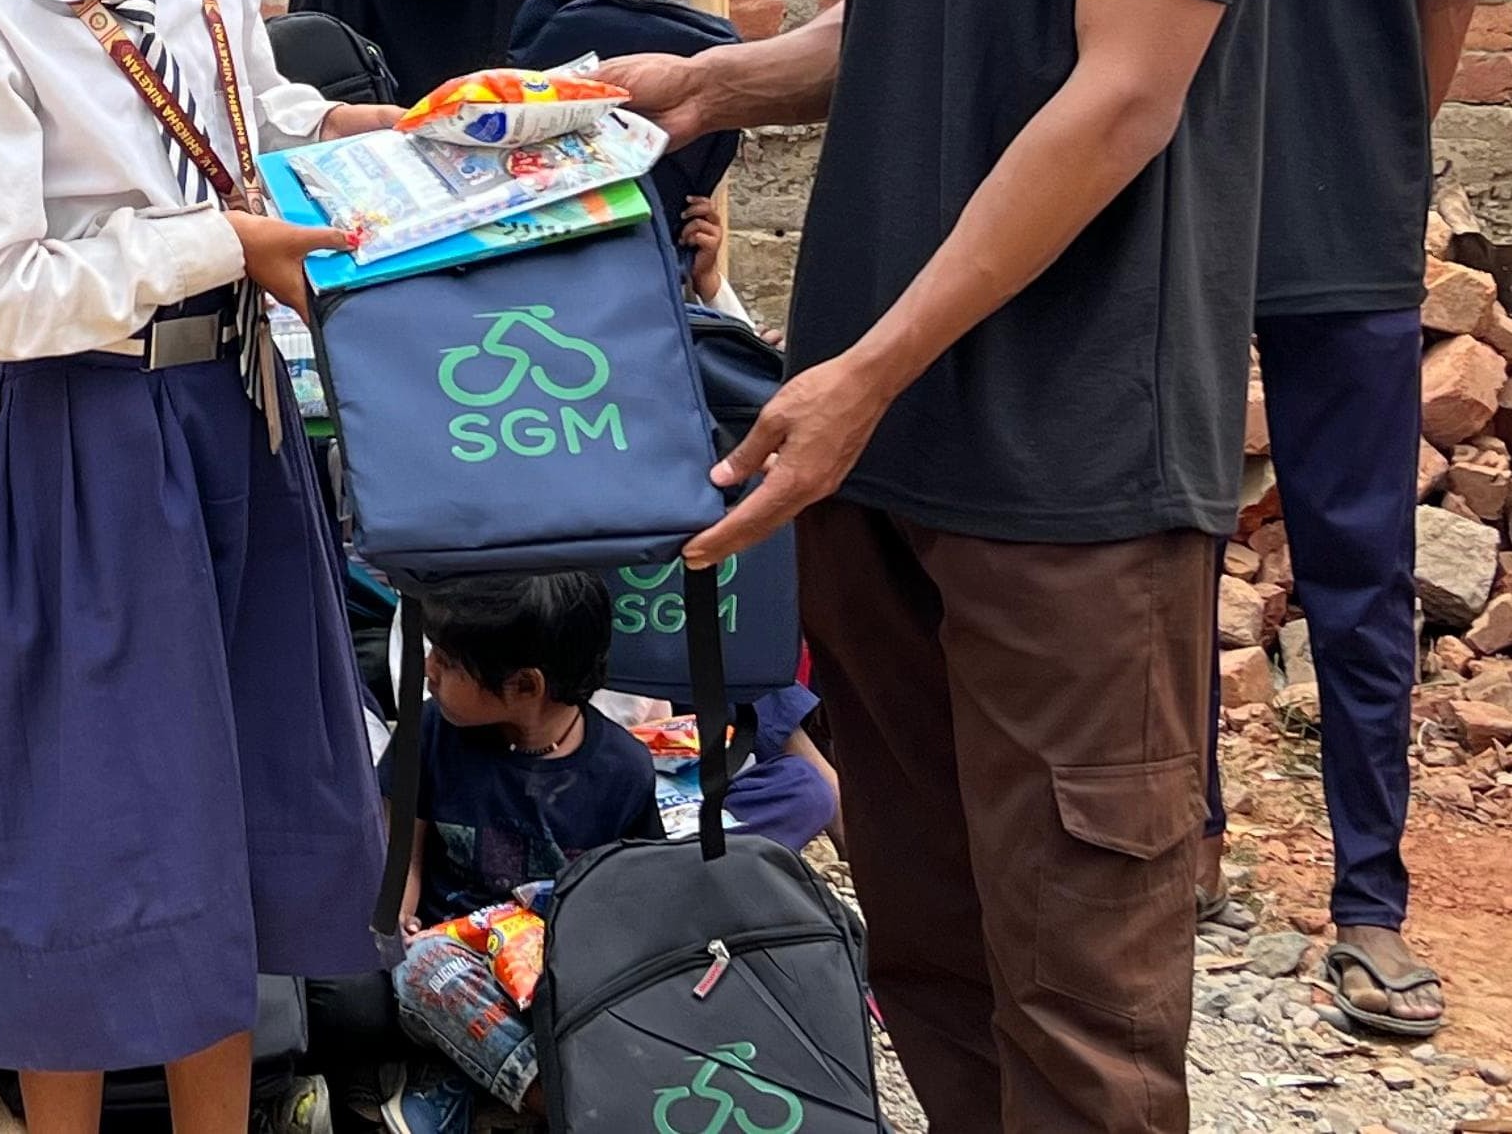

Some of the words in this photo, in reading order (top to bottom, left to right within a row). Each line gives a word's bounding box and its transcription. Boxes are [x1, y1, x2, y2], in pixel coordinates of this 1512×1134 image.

[122, 53, 166, 108] NIKETAN
[213, 22, 233, 82] NIKETAN
[162, 104, 204, 158] SHIKSHA
[227, 86, 248, 146] SHIKSHA
[448, 403, 628, 463] SGM
